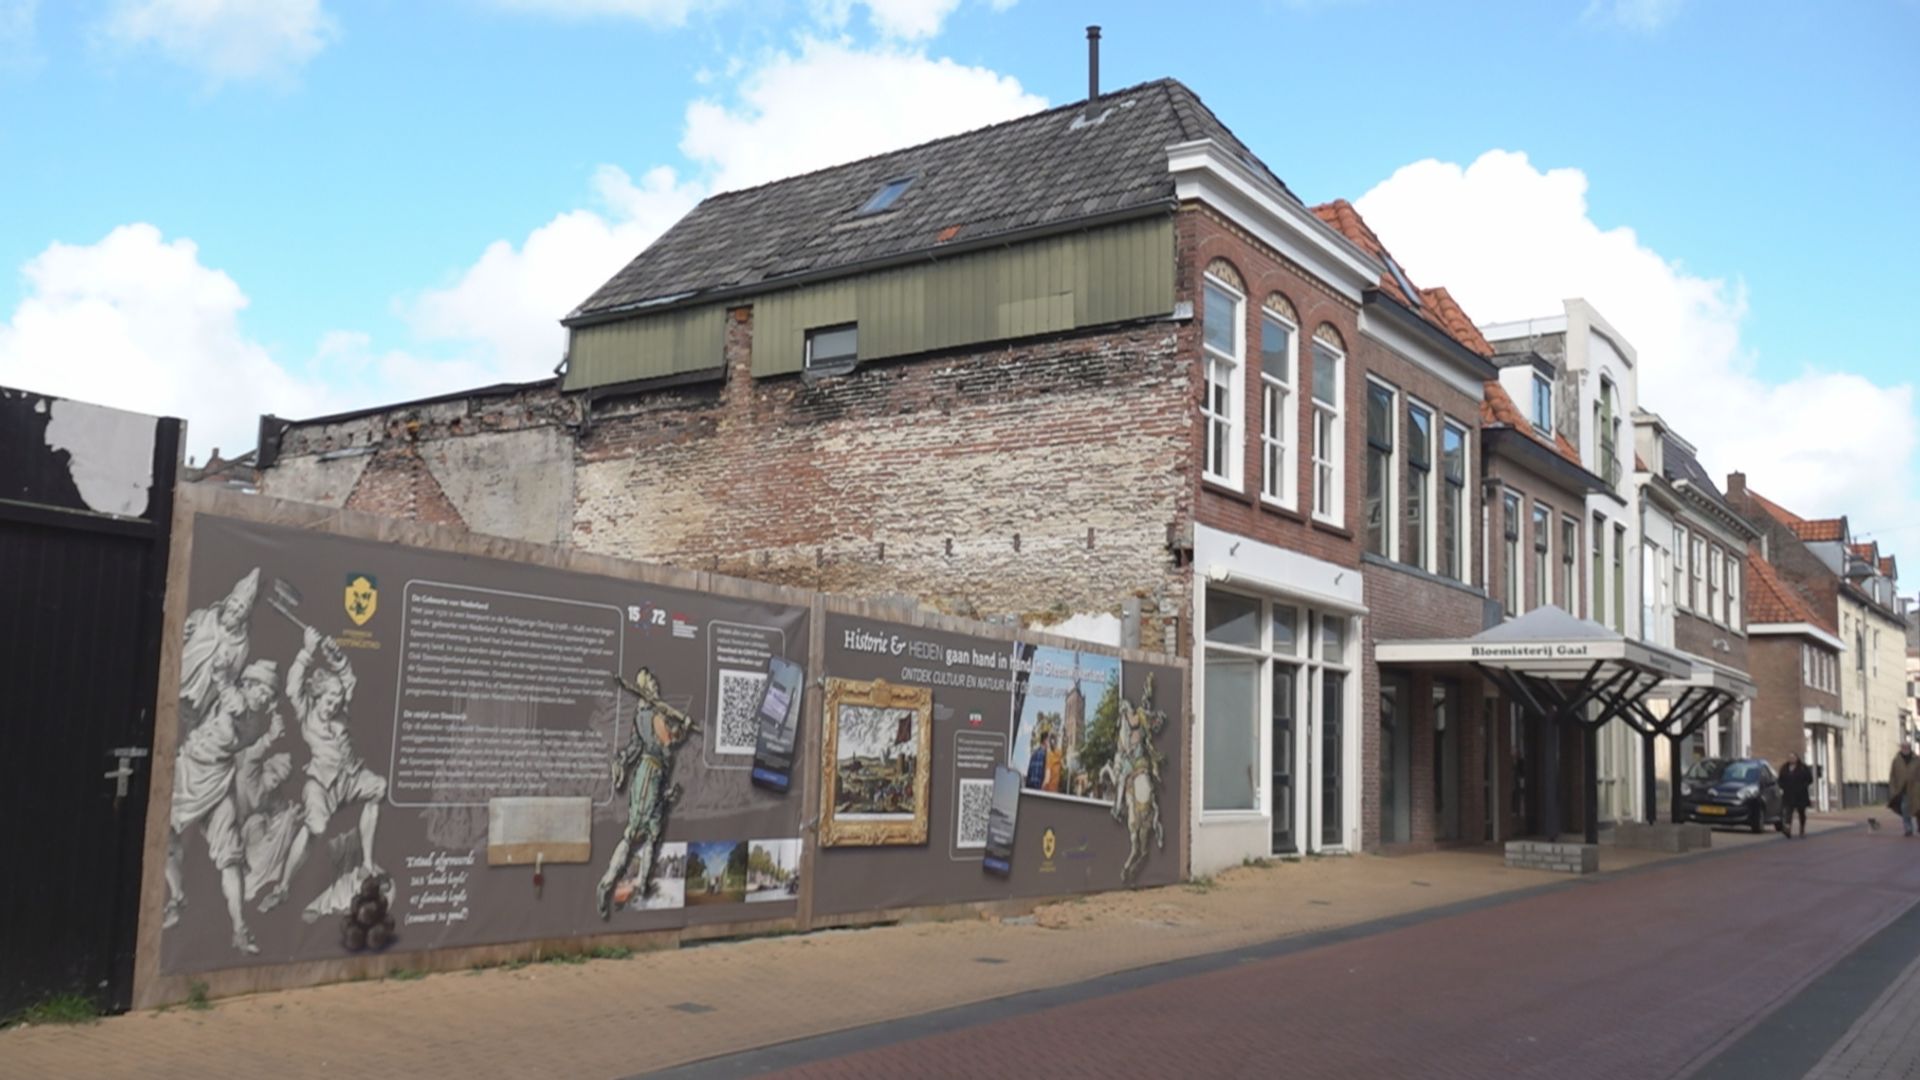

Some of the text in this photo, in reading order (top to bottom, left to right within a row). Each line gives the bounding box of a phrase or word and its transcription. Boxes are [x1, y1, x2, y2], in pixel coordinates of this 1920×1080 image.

[844, 628, 888, 654] Historie
[890, 635, 906, 655] &
[908, 641, 943, 660] HEDEN
[946, 648, 970, 666] gaan
[972, 648, 996, 668] hand
[998, 651, 1007, 669] in
[1009, 654, 1031, 672] hand
[1471, 645, 1588, 658] Bloemisterij Gaal
[901, 667, 931, 683] ONTDEK
[932, 671, 965, 687] CULTUUR
[966, 674, 976, 688] EN
[976, 675, 1006, 691] NATUUR
